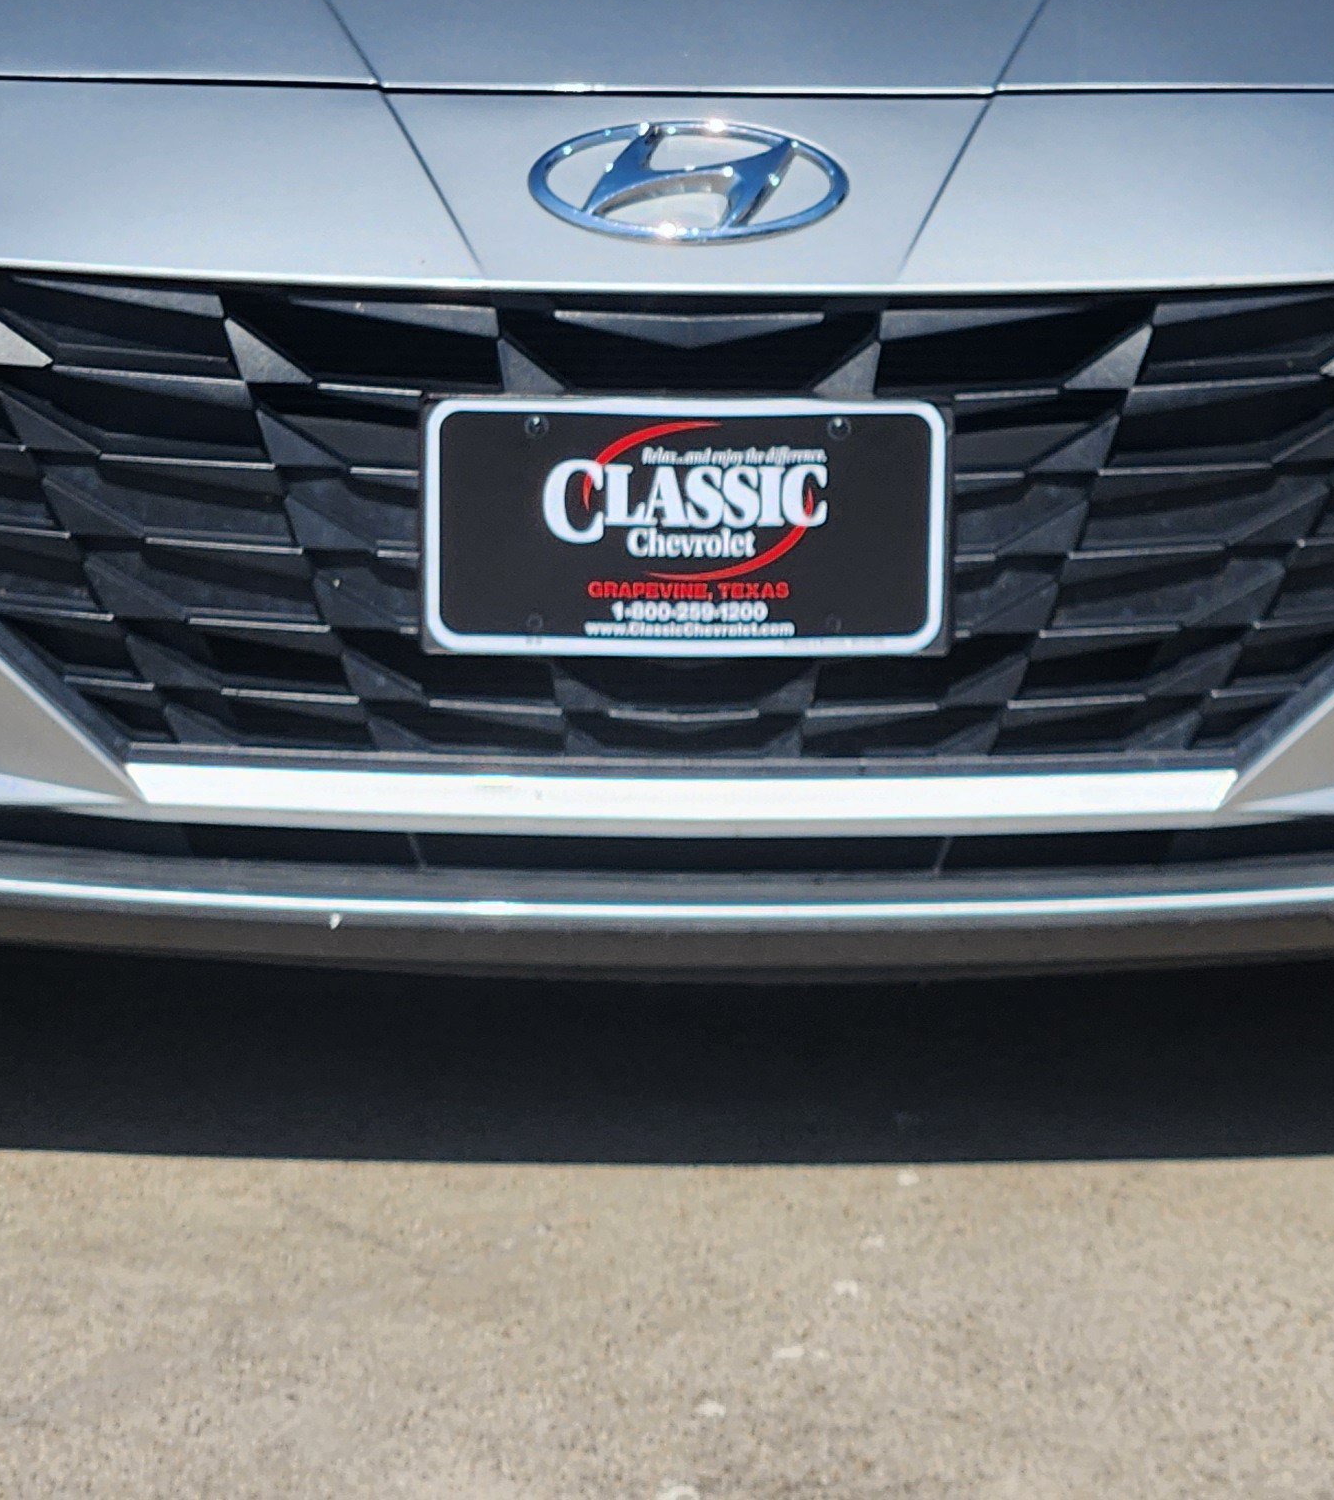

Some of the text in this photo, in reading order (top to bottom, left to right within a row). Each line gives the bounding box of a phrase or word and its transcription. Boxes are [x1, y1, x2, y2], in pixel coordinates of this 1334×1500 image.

[744, 446, 765, 464] the
[543, 458, 828, 544] CLASSIC
[626, 527, 757, 558] Chevrolet
[587, 580, 790, 601] GRAPEVINE, TEXAS
